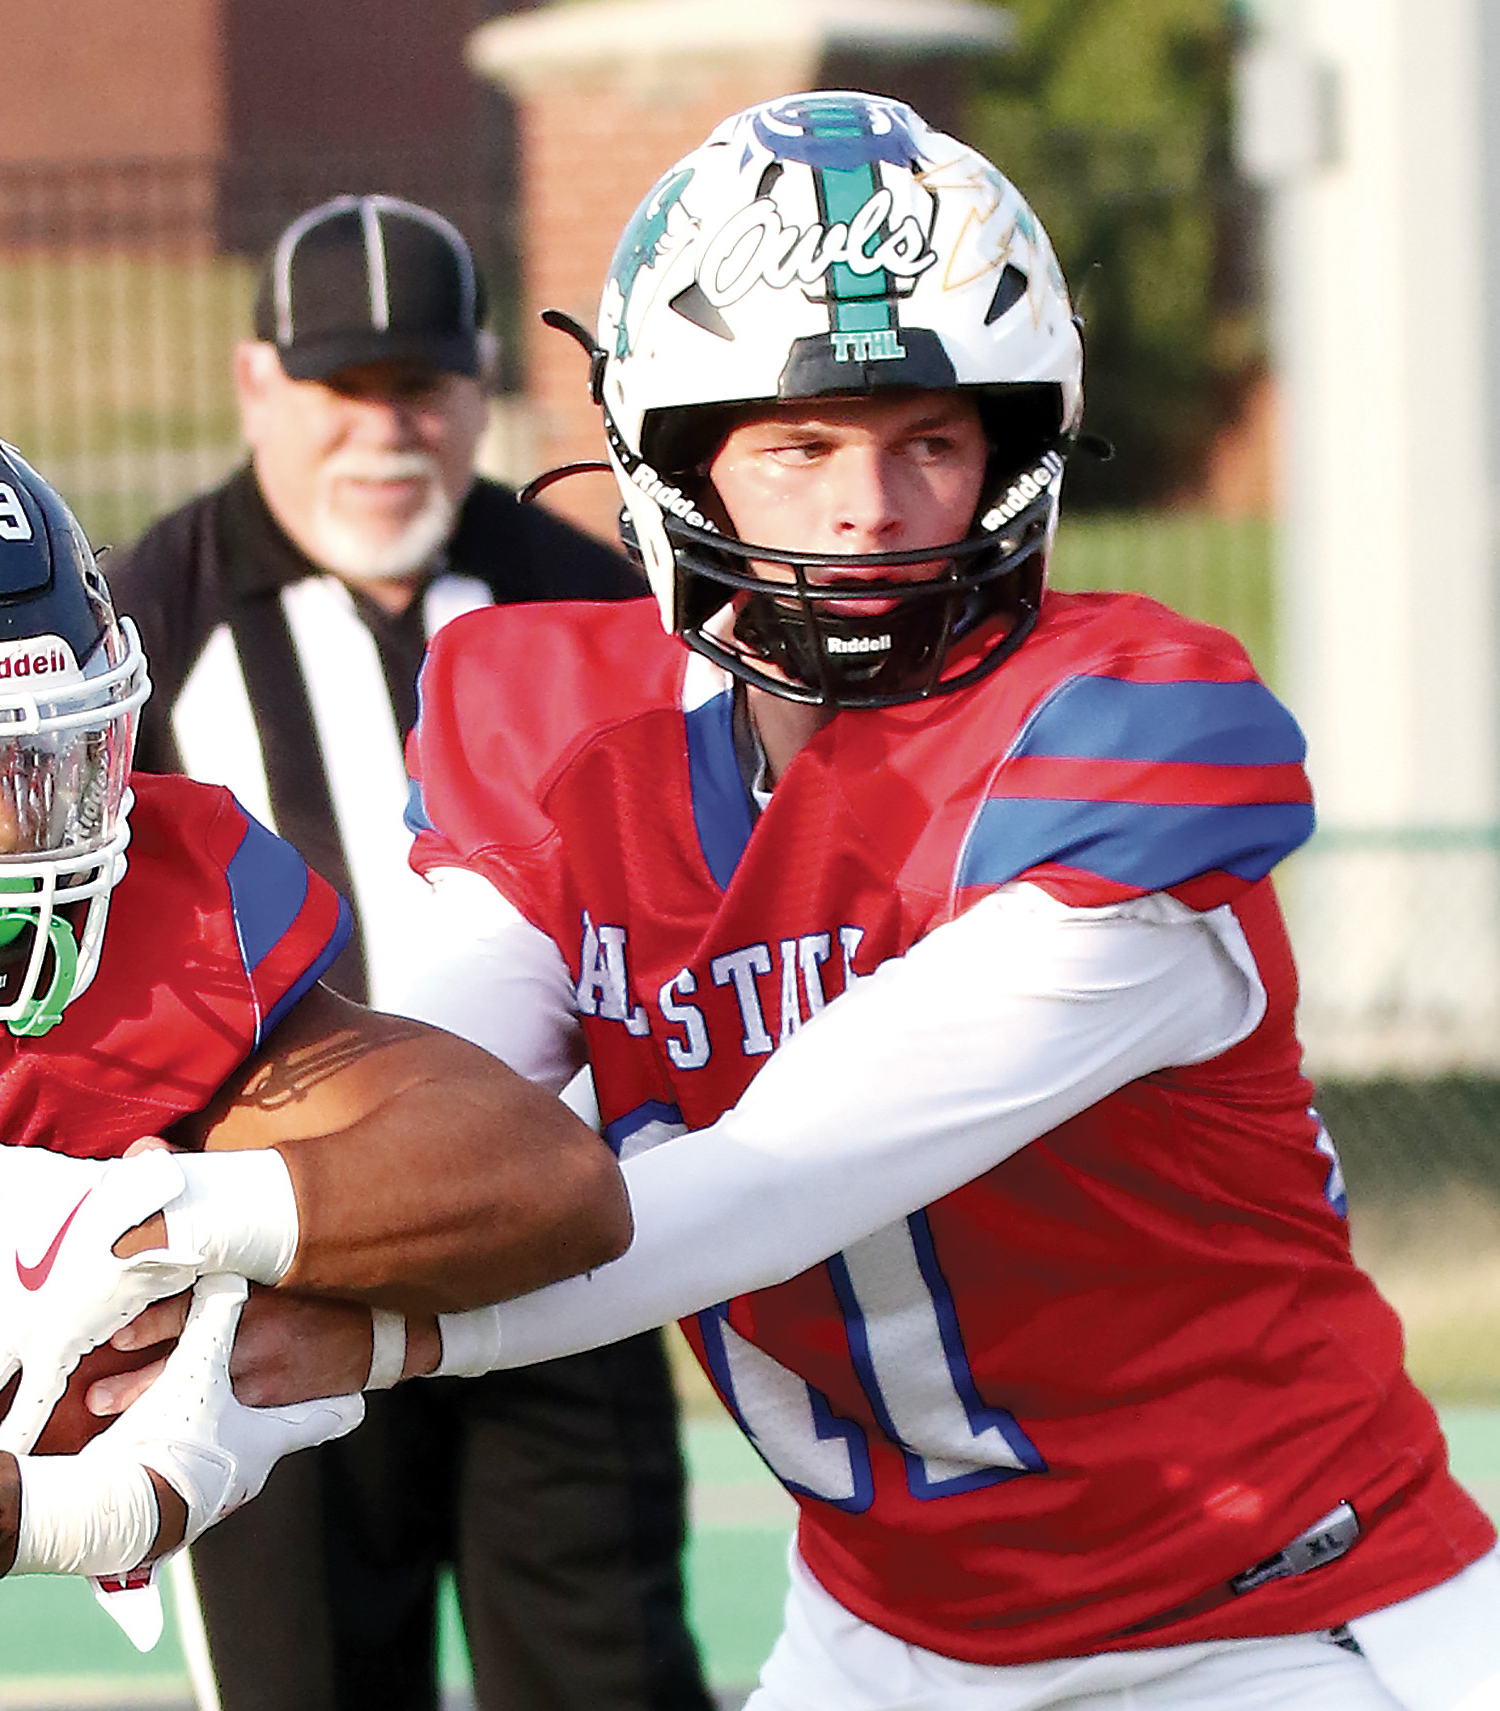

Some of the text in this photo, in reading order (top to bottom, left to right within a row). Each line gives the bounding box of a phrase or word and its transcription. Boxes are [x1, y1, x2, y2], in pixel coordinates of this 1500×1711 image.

[700, 189, 938, 308] Owls
[831, 330, 906, 361] TTHL
[981, 451, 1060, 531] Riddell
[827, 635, 891, 653] Riddell
